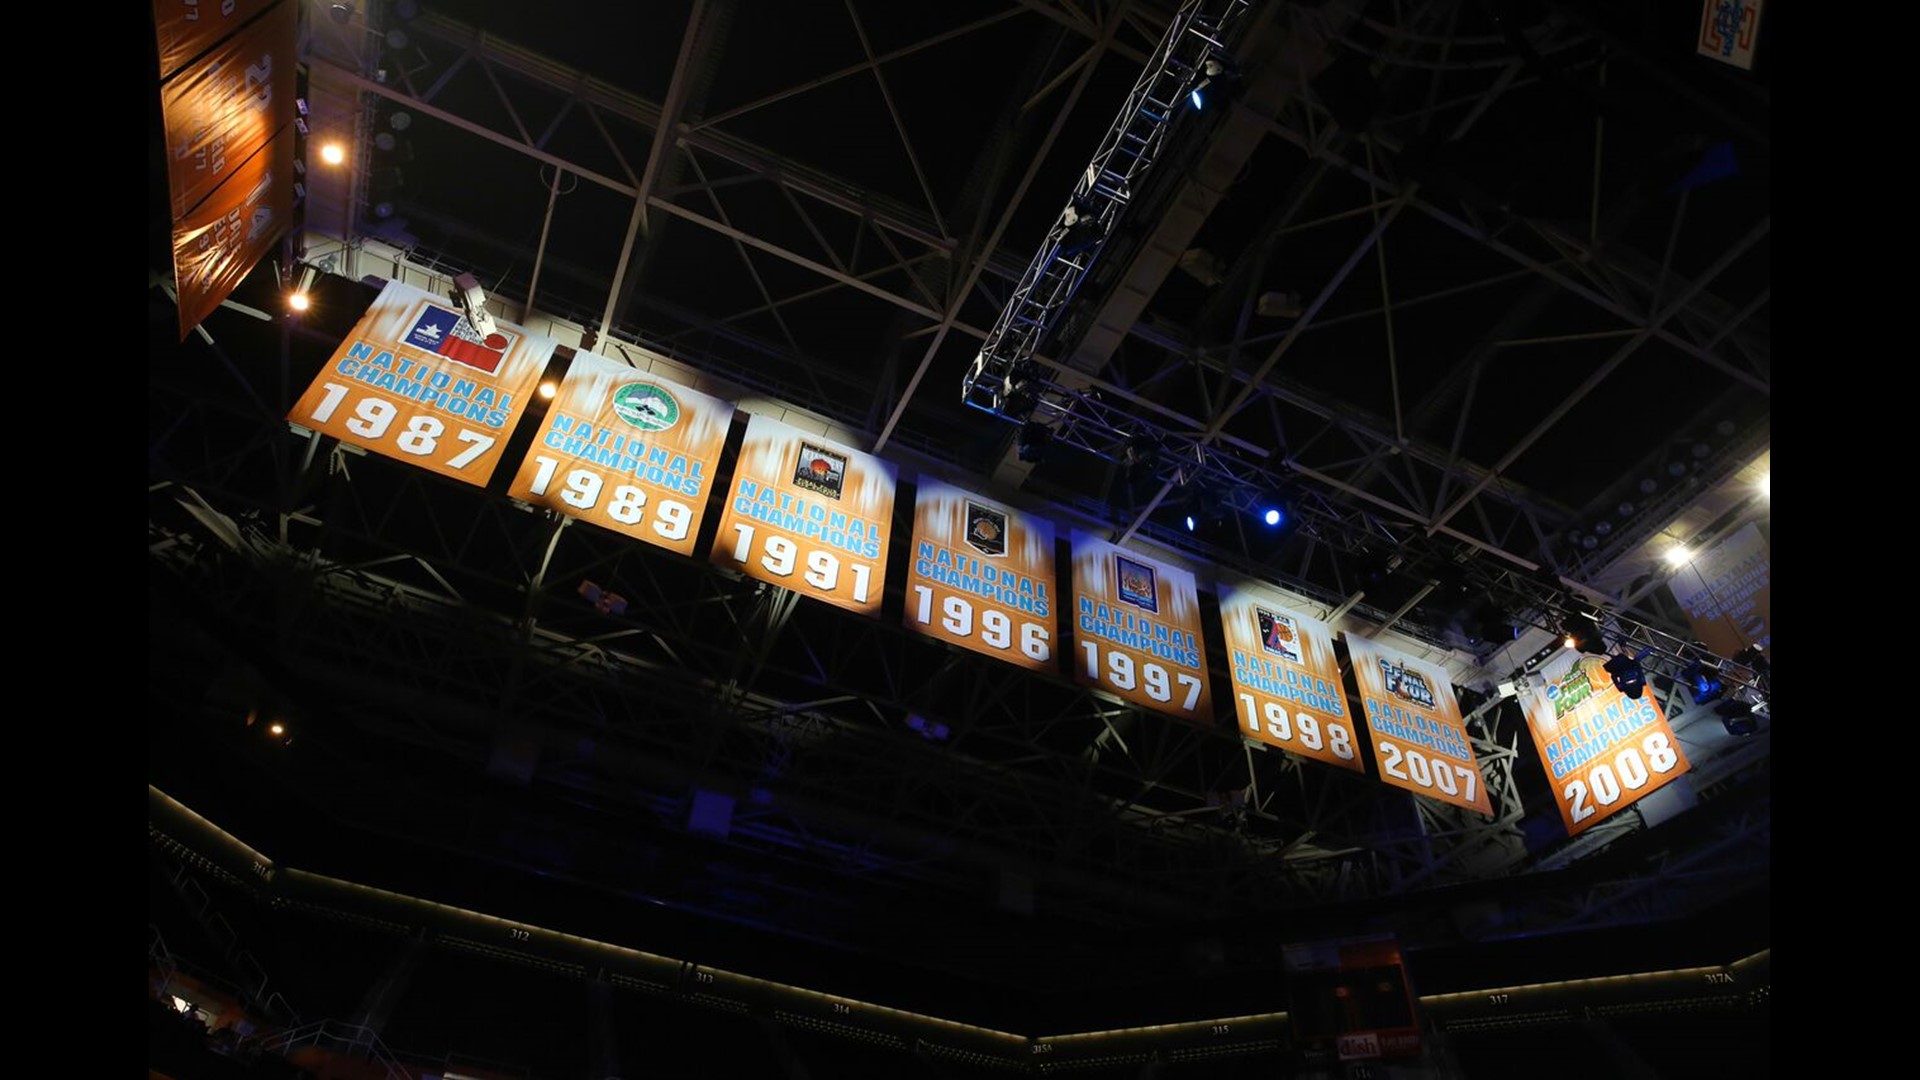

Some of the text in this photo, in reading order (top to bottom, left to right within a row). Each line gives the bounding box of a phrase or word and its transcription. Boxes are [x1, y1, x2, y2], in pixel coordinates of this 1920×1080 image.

[337, 359, 507, 429] CHAMPIONS
[347, 342, 513, 413] NATIONAL
[311, 382, 495, 470] 1987
[552, 413, 705, 481] NATIONAL
[544, 431, 700, 497] CHAMPIONS
[529, 455, 693, 541] 1989
[733, 497, 879, 559] CHAMPIONS
[738, 479, 882, 543] NATIONAL
[733, 523, 872, 604] 1991
[916, 560, 1049, 619] CHAMPIONS
[918, 542, 1049, 601] NATIONAL
[914, 585, 1051, 662] 1996
[1079, 614, 1201, 669] CHAMPIONS
[1080, 596, 1199, 651] NATIONAL
[1081, 641, 1202, 711] 1997
[1234, 650, 1340, 700] NATIONAL
[1236, 668, 1343, 717] CHAMPIONS
[1240, 693, 1354, 761] 1998
[1367, 698, 1466, 744] NATIONAL
[1371, 715, 1470, 761] CHAMPIONS
[1551, 706, 1659, 779] CHAMPIONS
[1379, 742, 1477, 802] 2007
[1563, 732, 1679, 826] 2008
[511, 928, 531, 943] 312
[695, 971, 714, 985] 313
[1488, 994, 1509, 1006] 317
[1704, 972, 1734, 985] 317A
[1211, 1024, 1231, 1036] 315
[1340, 1036, 1376, 1057] dish
